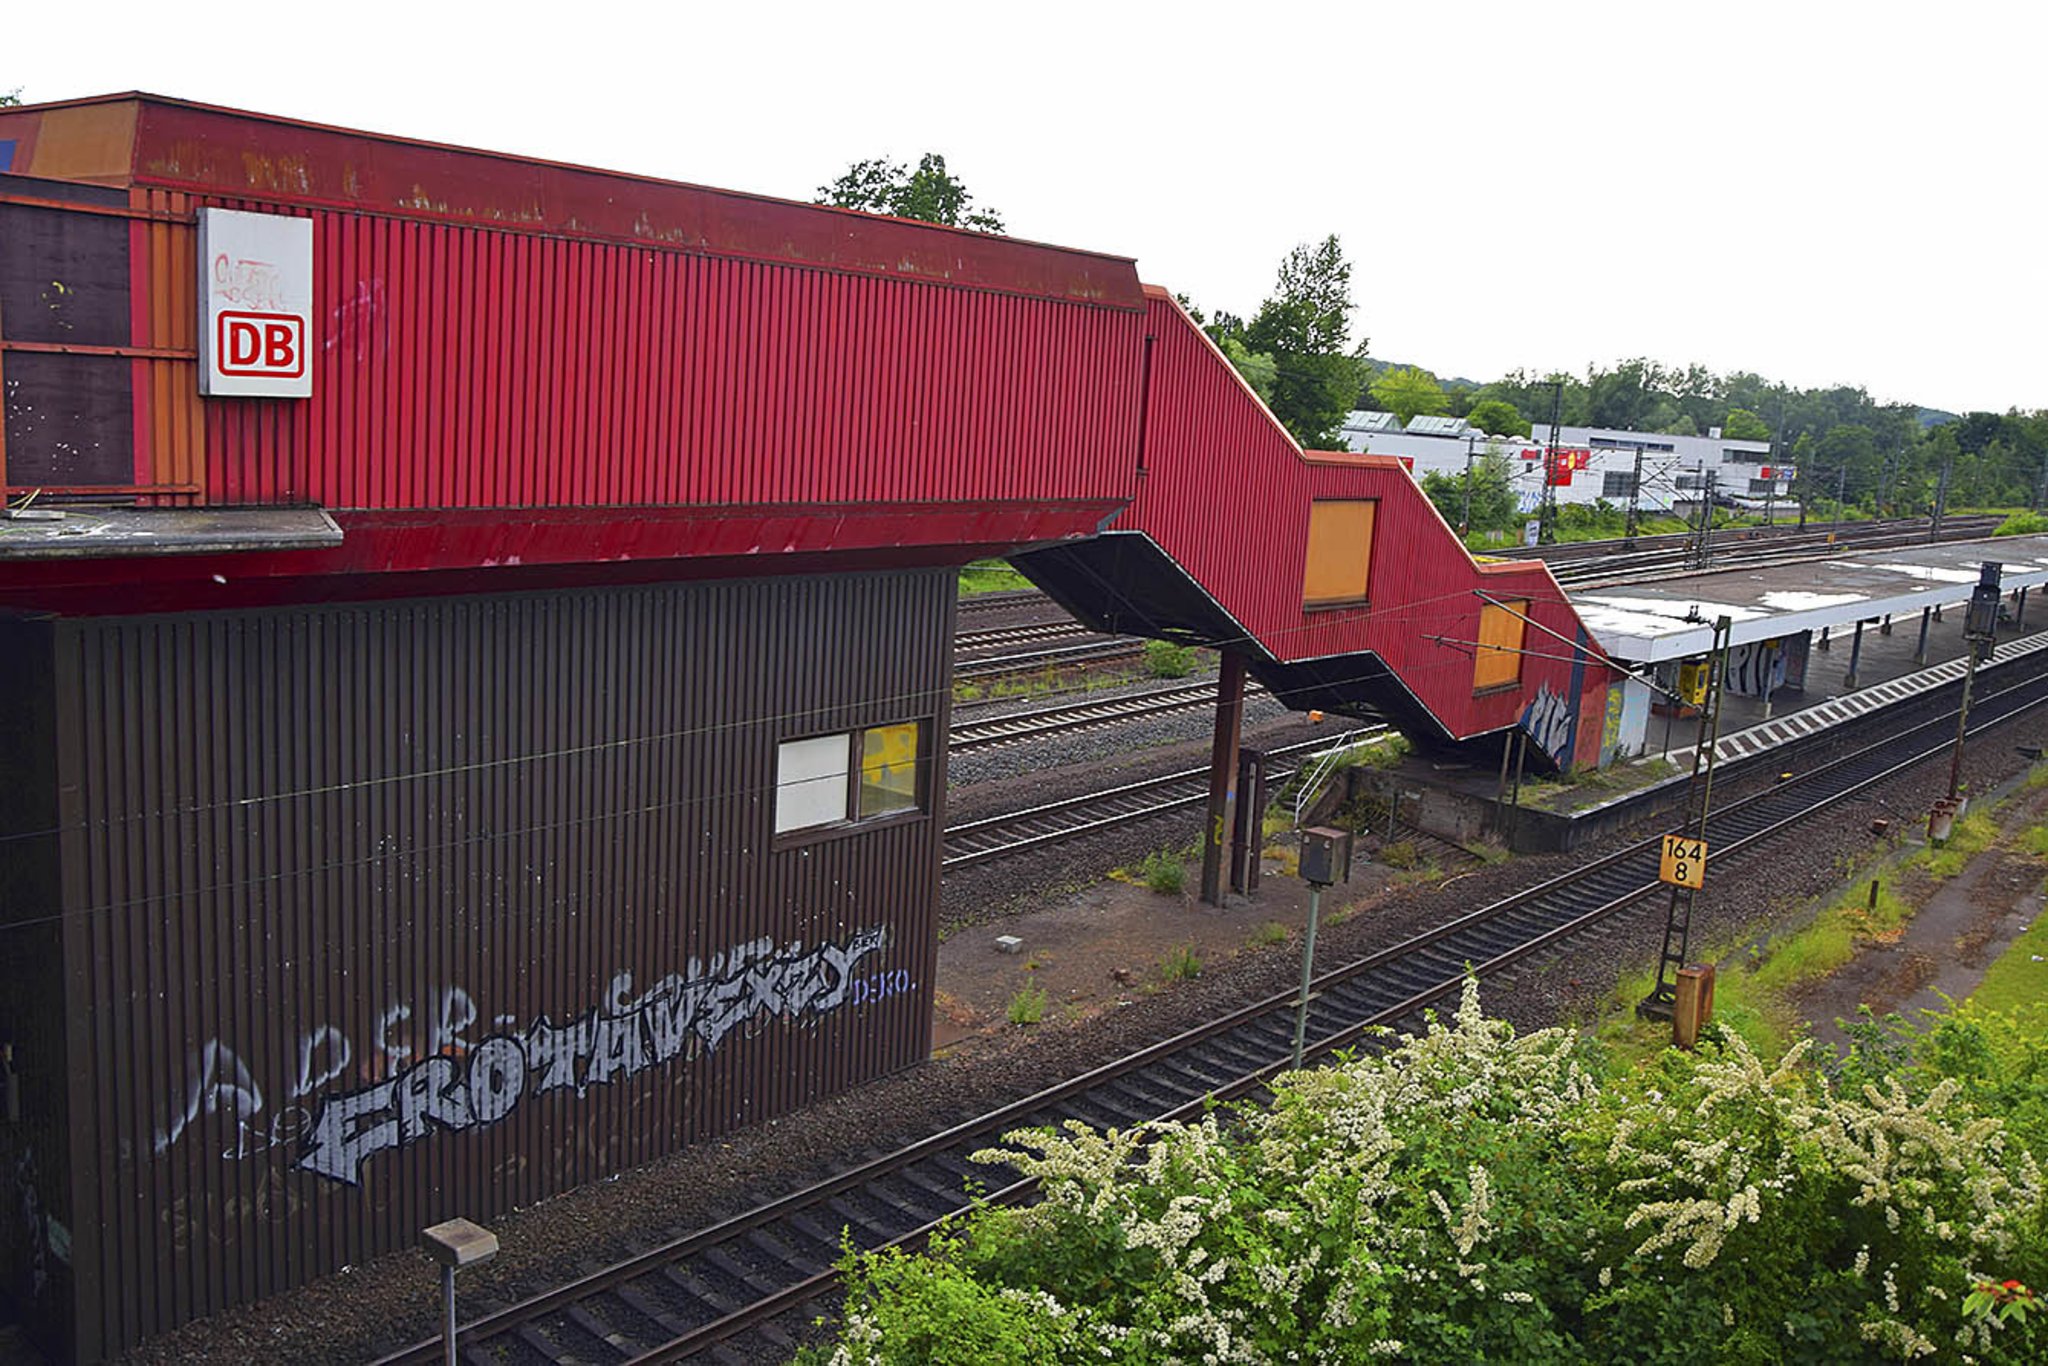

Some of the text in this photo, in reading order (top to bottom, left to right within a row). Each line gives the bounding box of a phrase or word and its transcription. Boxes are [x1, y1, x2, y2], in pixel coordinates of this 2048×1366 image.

[229, 321, 295, 368] DB
[1667, 837, 1702, 863] 164
[1675, 861, 1688, 881] 8
